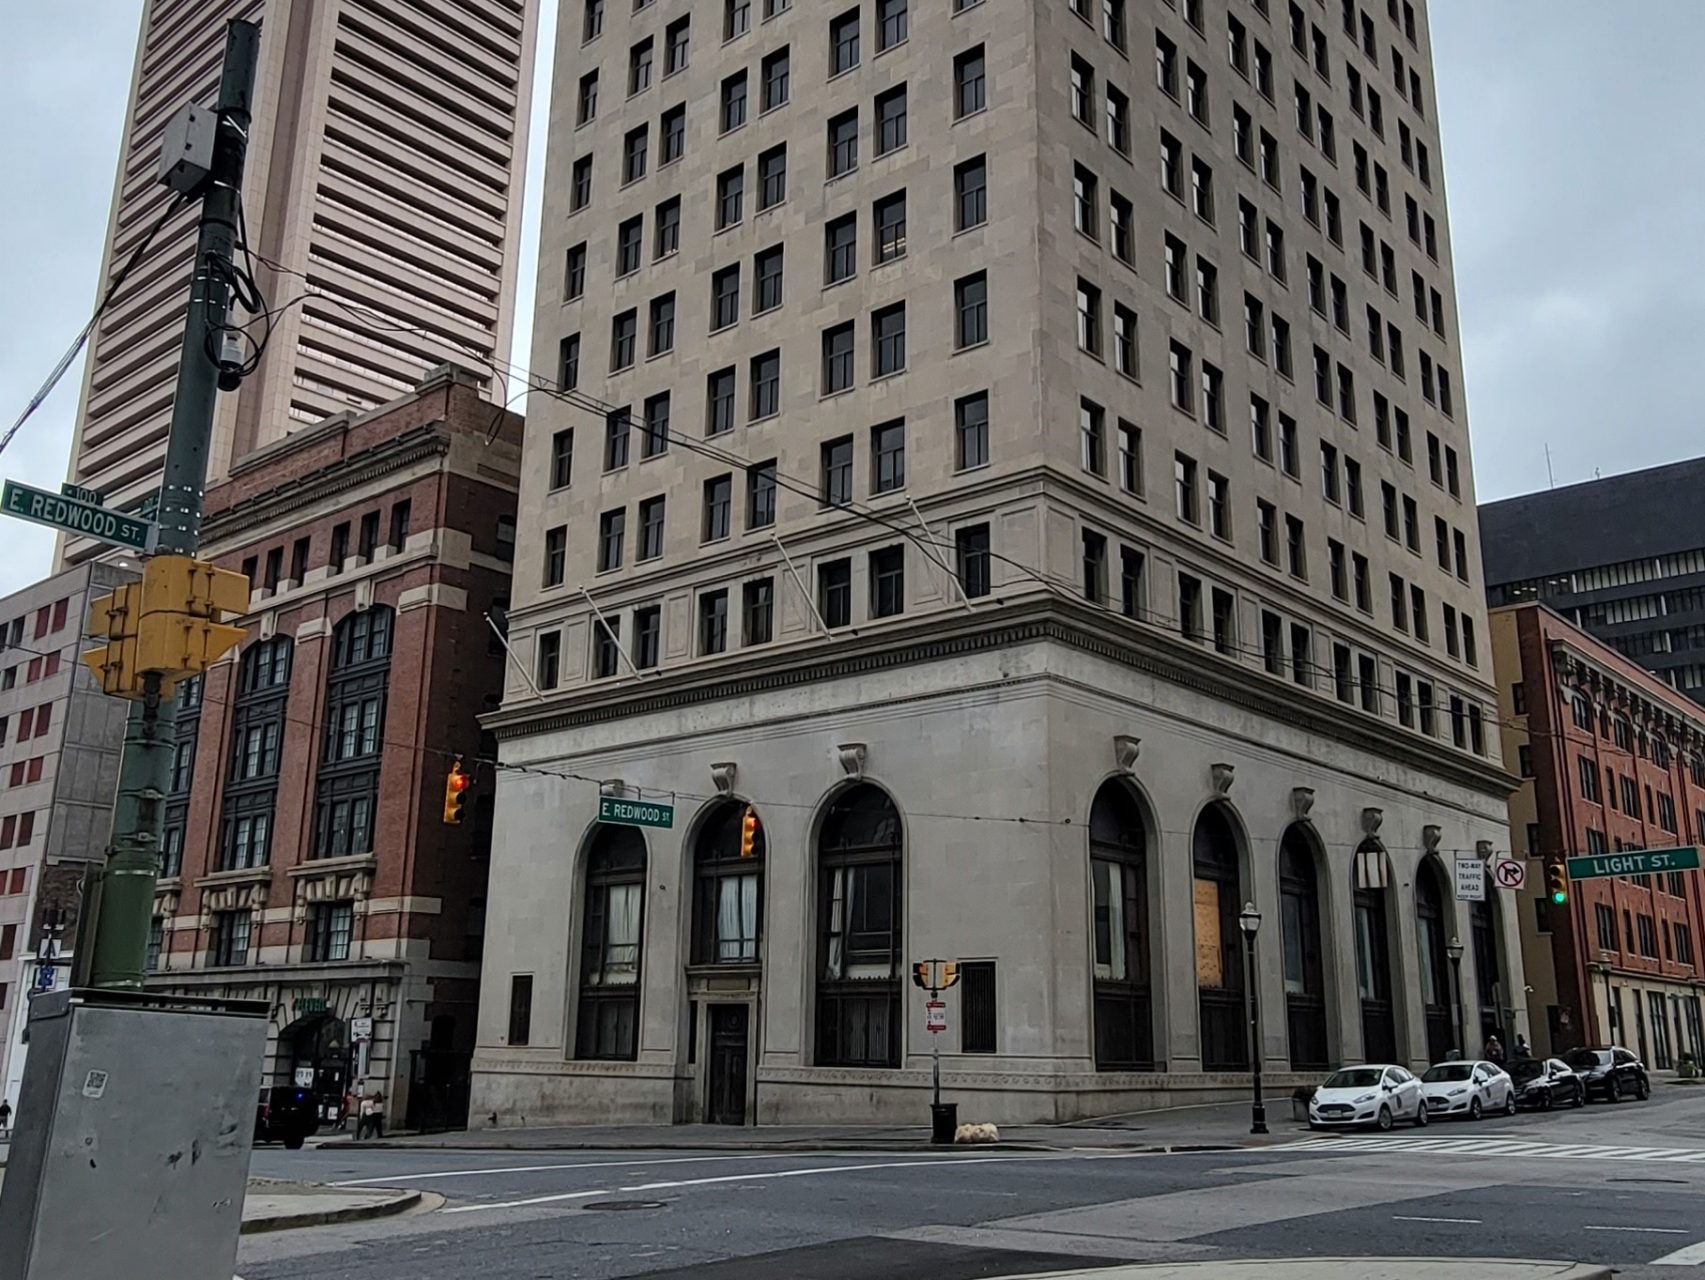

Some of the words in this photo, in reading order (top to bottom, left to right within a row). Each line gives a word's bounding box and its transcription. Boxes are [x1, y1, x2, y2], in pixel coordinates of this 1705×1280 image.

[76, 487, 97, 505] 100
[9, 488, 24, 512] E.
[30, 494, 116, 537] REDWOOD
[121, 524, 141, 541] ST.
[614, 803, 660, 822] REDWOOD
[1593, 856, 1645, 874] LIGHT
[1651, 854, 1676, 868] ST.
[1460, 883, 1479, 891] AHEAD
